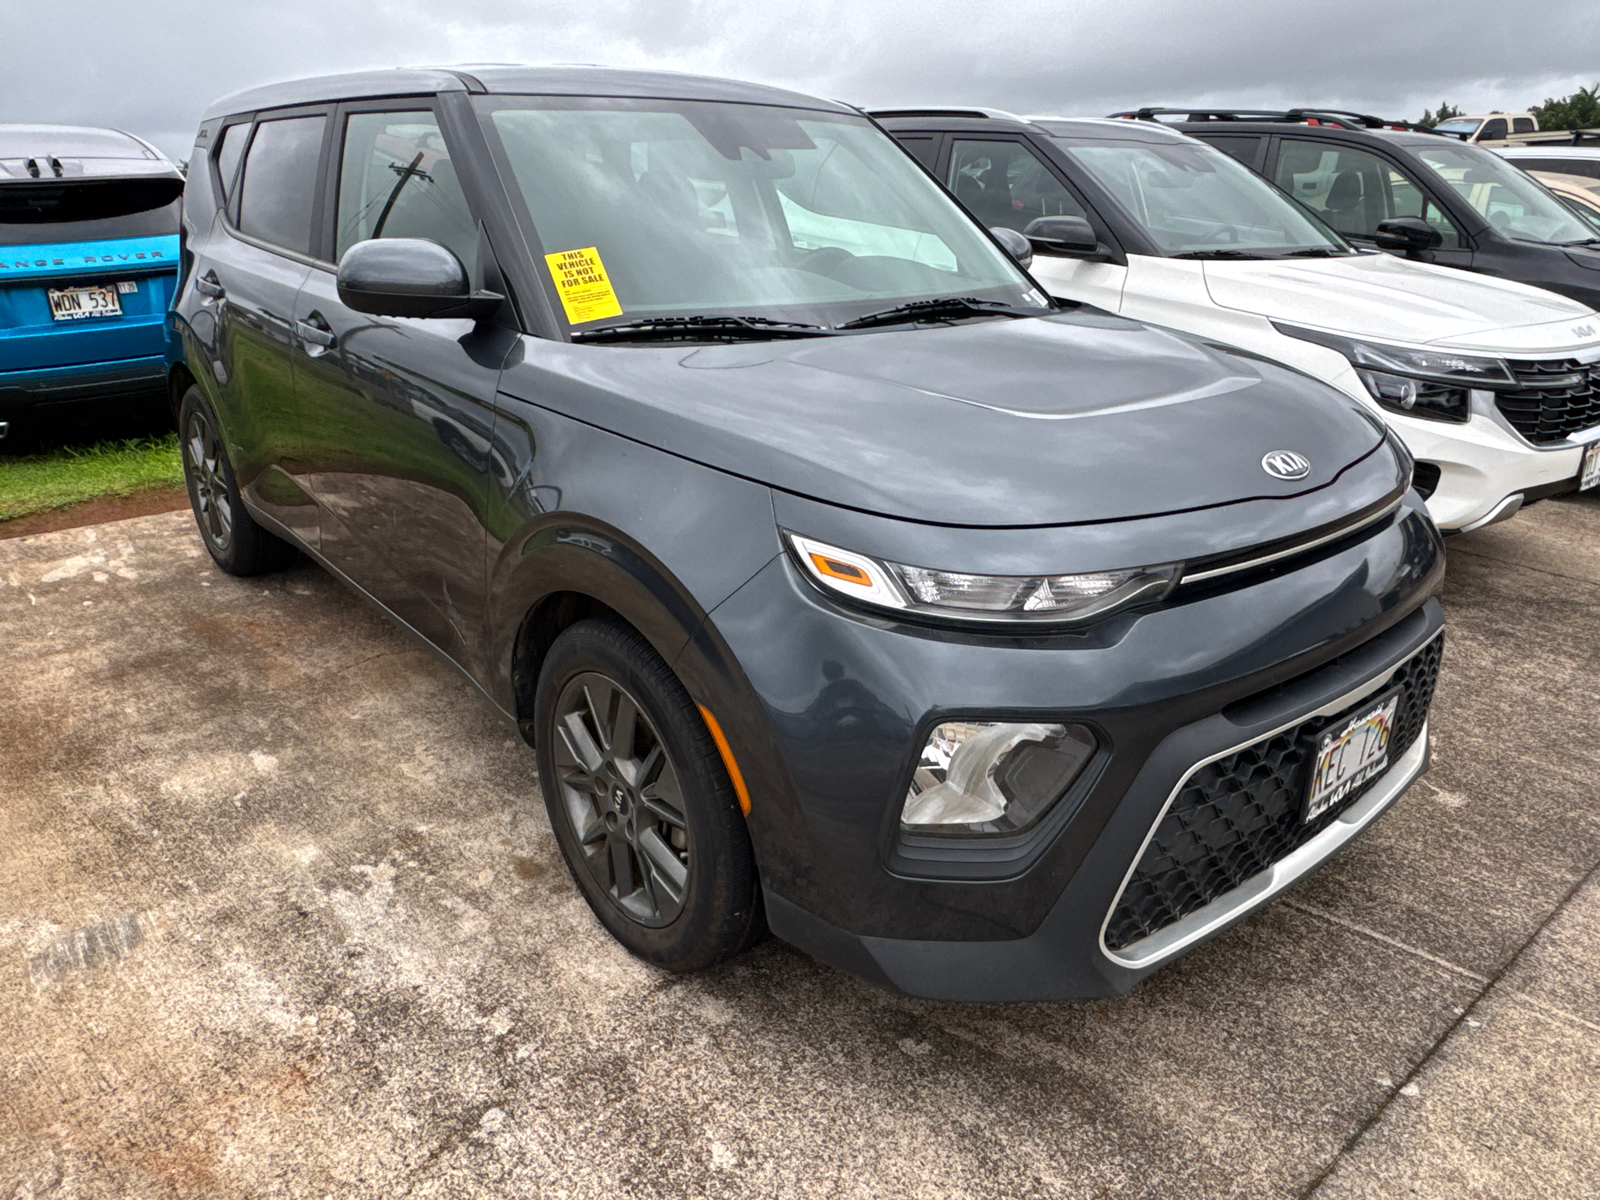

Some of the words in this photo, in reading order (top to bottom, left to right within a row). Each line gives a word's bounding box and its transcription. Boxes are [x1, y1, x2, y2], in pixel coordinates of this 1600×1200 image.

[84, 251, 163, 263] ROVER
[561, 251, 584, 261] THIS
[556, 257, 596, 271] VEHICLE
[564, 270, 574, 278] IS
[576, 266, 594, 276] NOT
[561, 278, 580, 288] FOR
[581, 273, 604, 285] SALE
[51, 293, 82, 312] WDN
[88, 290, 116, 309] 537
[1571, 325, 1596, 338] KIA
[1267, 452, 1308, 475] KIA
[1311, 738, 1351, 800] KEC
[1359, 709, 1394, 766] 126
[614, 789, 624, 812] KIA
